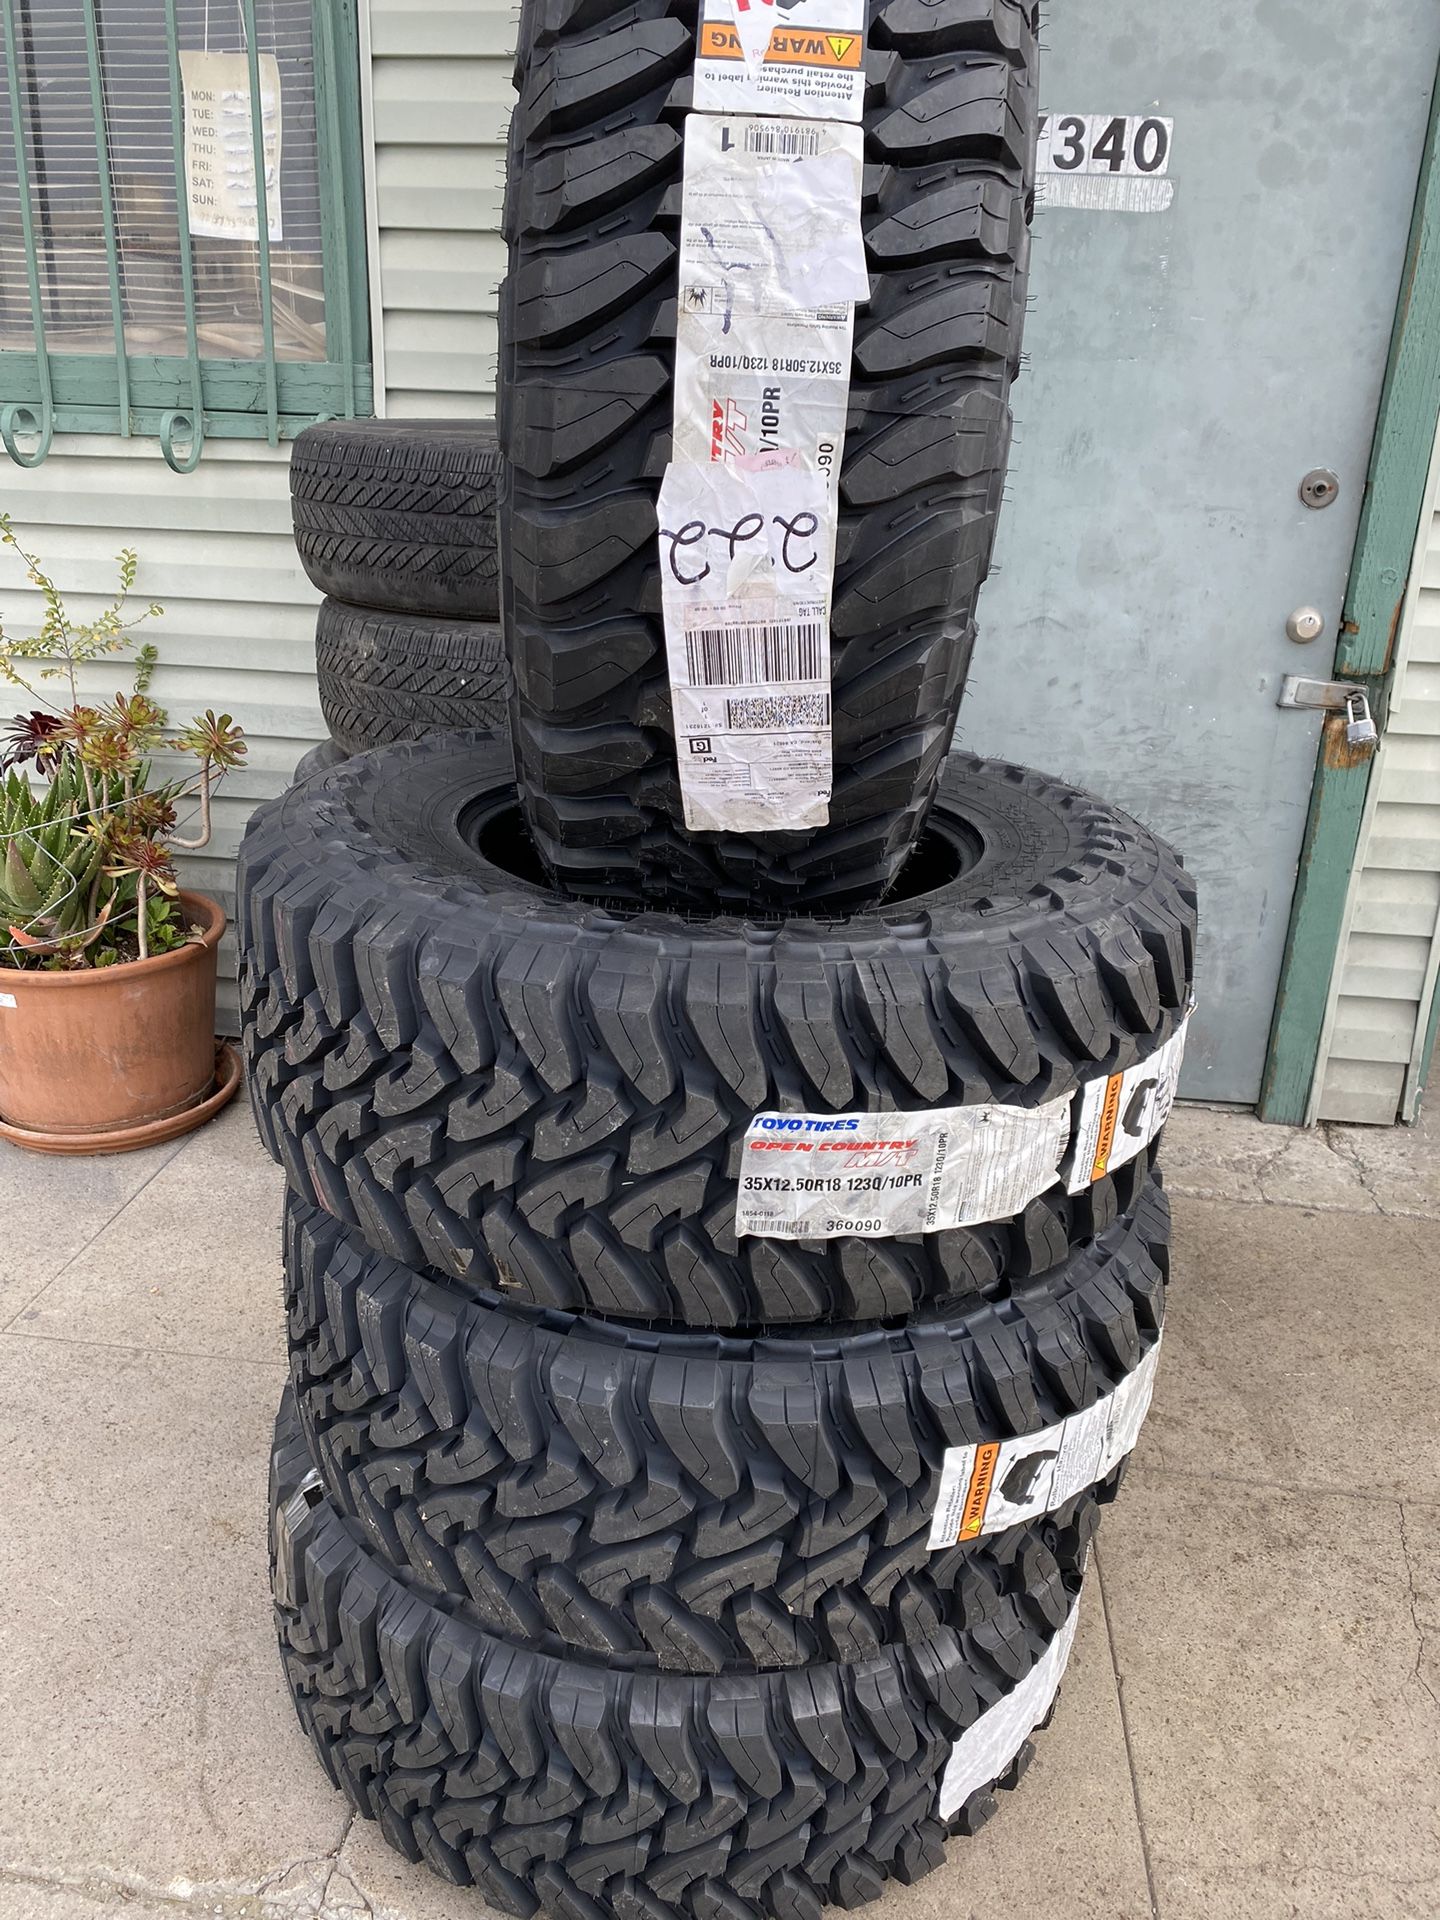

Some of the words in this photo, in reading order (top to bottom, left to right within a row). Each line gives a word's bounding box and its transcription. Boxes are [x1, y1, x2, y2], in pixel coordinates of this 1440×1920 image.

[711, 31, 826, 55] WARNG
[704, 73, 715, 81] to
[718, 74, 744, 83] label
[760, 66, 803, 79] purchas
[806, 70, 834, 80] retail
[837, 72, 854, 81] the
[746, 74, 788, 85] warni
[792, 78, 811, 89] this
[814, 80, 853, 91] Provide
[191, 90, 216, 101] MON:
[756, 85, 801, 97] Retailer:
[804, 89, 852, 100] Attention
[192, 108, 214, 119] TUE:
[192, 126, 218, 137] WED:
[748, 124, 781, 132] 849506
[784, 126, 816, 135] 981910
[721, 127, 735, 152] 1
[192, 143, 216, 155] THU:
[192, 160, 212, 172] FRI:
[192, 177, 214, 189] SAT:
[192, 194, 217, 206] SUN:
[710, 354, 769, 371] 123Q/10PR
[772, 356, 842, 375] 35X12.50R18
[760, 387, 781, 455] /10PR
[710, 399, 724, 462] TRY
[798, 607, 810, 617] TAG
[811, 606, 827, 616] CALL
[696, 741, 706, 752] G
[1100, 1079, 1118, 1157] WARNING
[753, 1117, 798, 1133] TOYO
[805, 1119, 860, 1132] TIRES
[750, 1141, 814, 1152] OPEN
[818, 1139, 919, 1152] COUNTRY
[844, 1149, 919, 1168] M/T
[744, 1177, 841, 1191] 35X12.50R18
[847, 1174, 923, 1191] 123Q/10PR
[926, 1176, 942, 1226] 35X12.50R18
[934, 1132, 949, 1174] 123Q/10PR
[826, 1219, 882, 1232] 360090
[969, 1449, 993, 1519] WARNING
